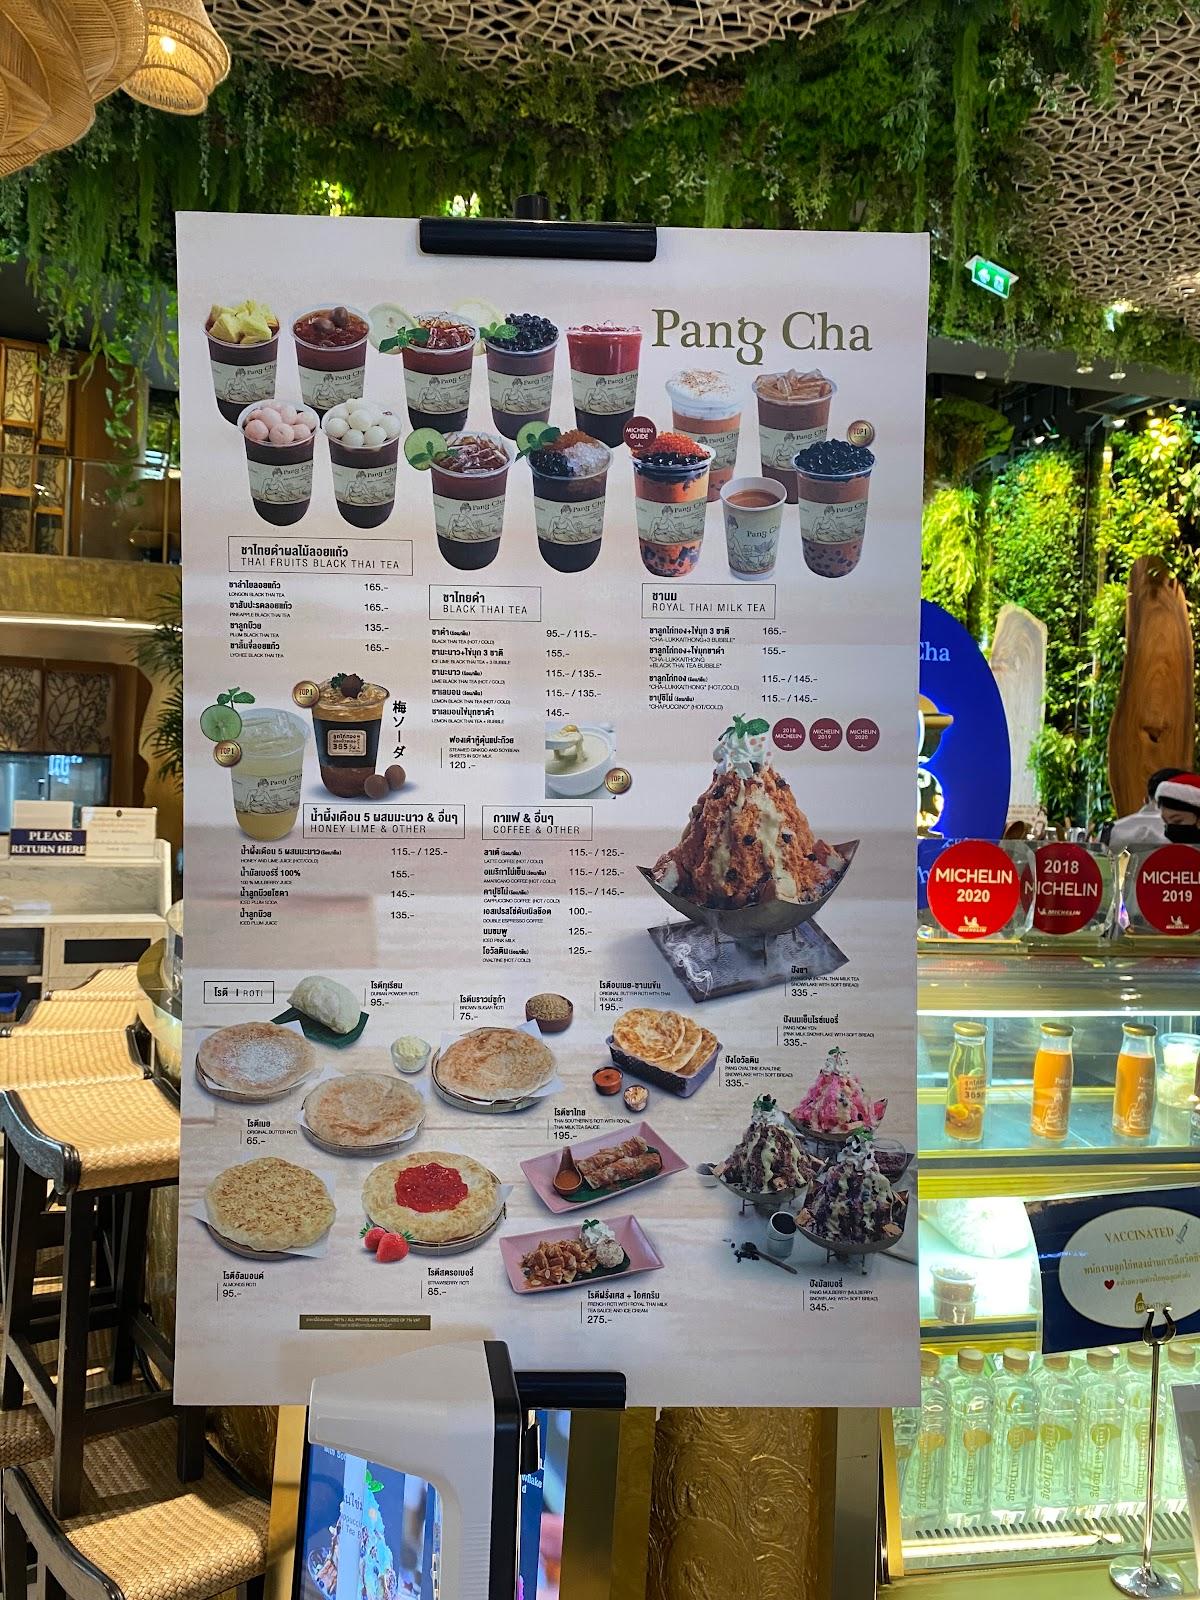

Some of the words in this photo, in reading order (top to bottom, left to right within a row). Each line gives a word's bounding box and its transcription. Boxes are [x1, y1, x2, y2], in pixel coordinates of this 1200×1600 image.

[652, 309, 766, 365] Pang
[783, 312, 872, 351] Cha
[271, 558, 307, 566] FRUITS
[314, 559, 346, 567] BLACK
[351, 560, 374, 568] THAI
[443, 591, 484, 603] ชาไทยดำ
[652, 593, 677, 601] ชานม
[444, 605, 475, 613] BLACK
[509, 606, 527, 614] TEA
[653, 603, 684, 611] ROYAL
[691, 603, 712, 611] THAI
[763, 627, 786, 635] 165.-
[364, 813, 370, 821] 5
[427, 814, 434, 822] &
[494, 812, 520, 822] กาแฟ
[523, 814, 530, 822] &
[393, 825, 425, 833] OTHER
[547, 826, 579, 834] OTHER
[28, 831, 72, 842] PLEASE
[11, 844, 54, 854] RETURN
[57, 844, 85, 854] HERE
[1044, 860, 1079, 874] 2018
[936, 868, 1012, 884] MICHELIN
[1024, 881, 1098, 896] MICHELIN
[956, 889, 990, 902] 2020
[1162, 890, 1192, 902] 2019
[214, 987, 228, 997] โรตี
[600, 1003, 623, 1011] 195.-
[726, 1079, 748, 1087] 335.-
[1104, 1226, 1174, 1243] VACCINATED
[223, 1289, 241, 1297] 95.-
[810, 1303, 833, 1311] 345.-
